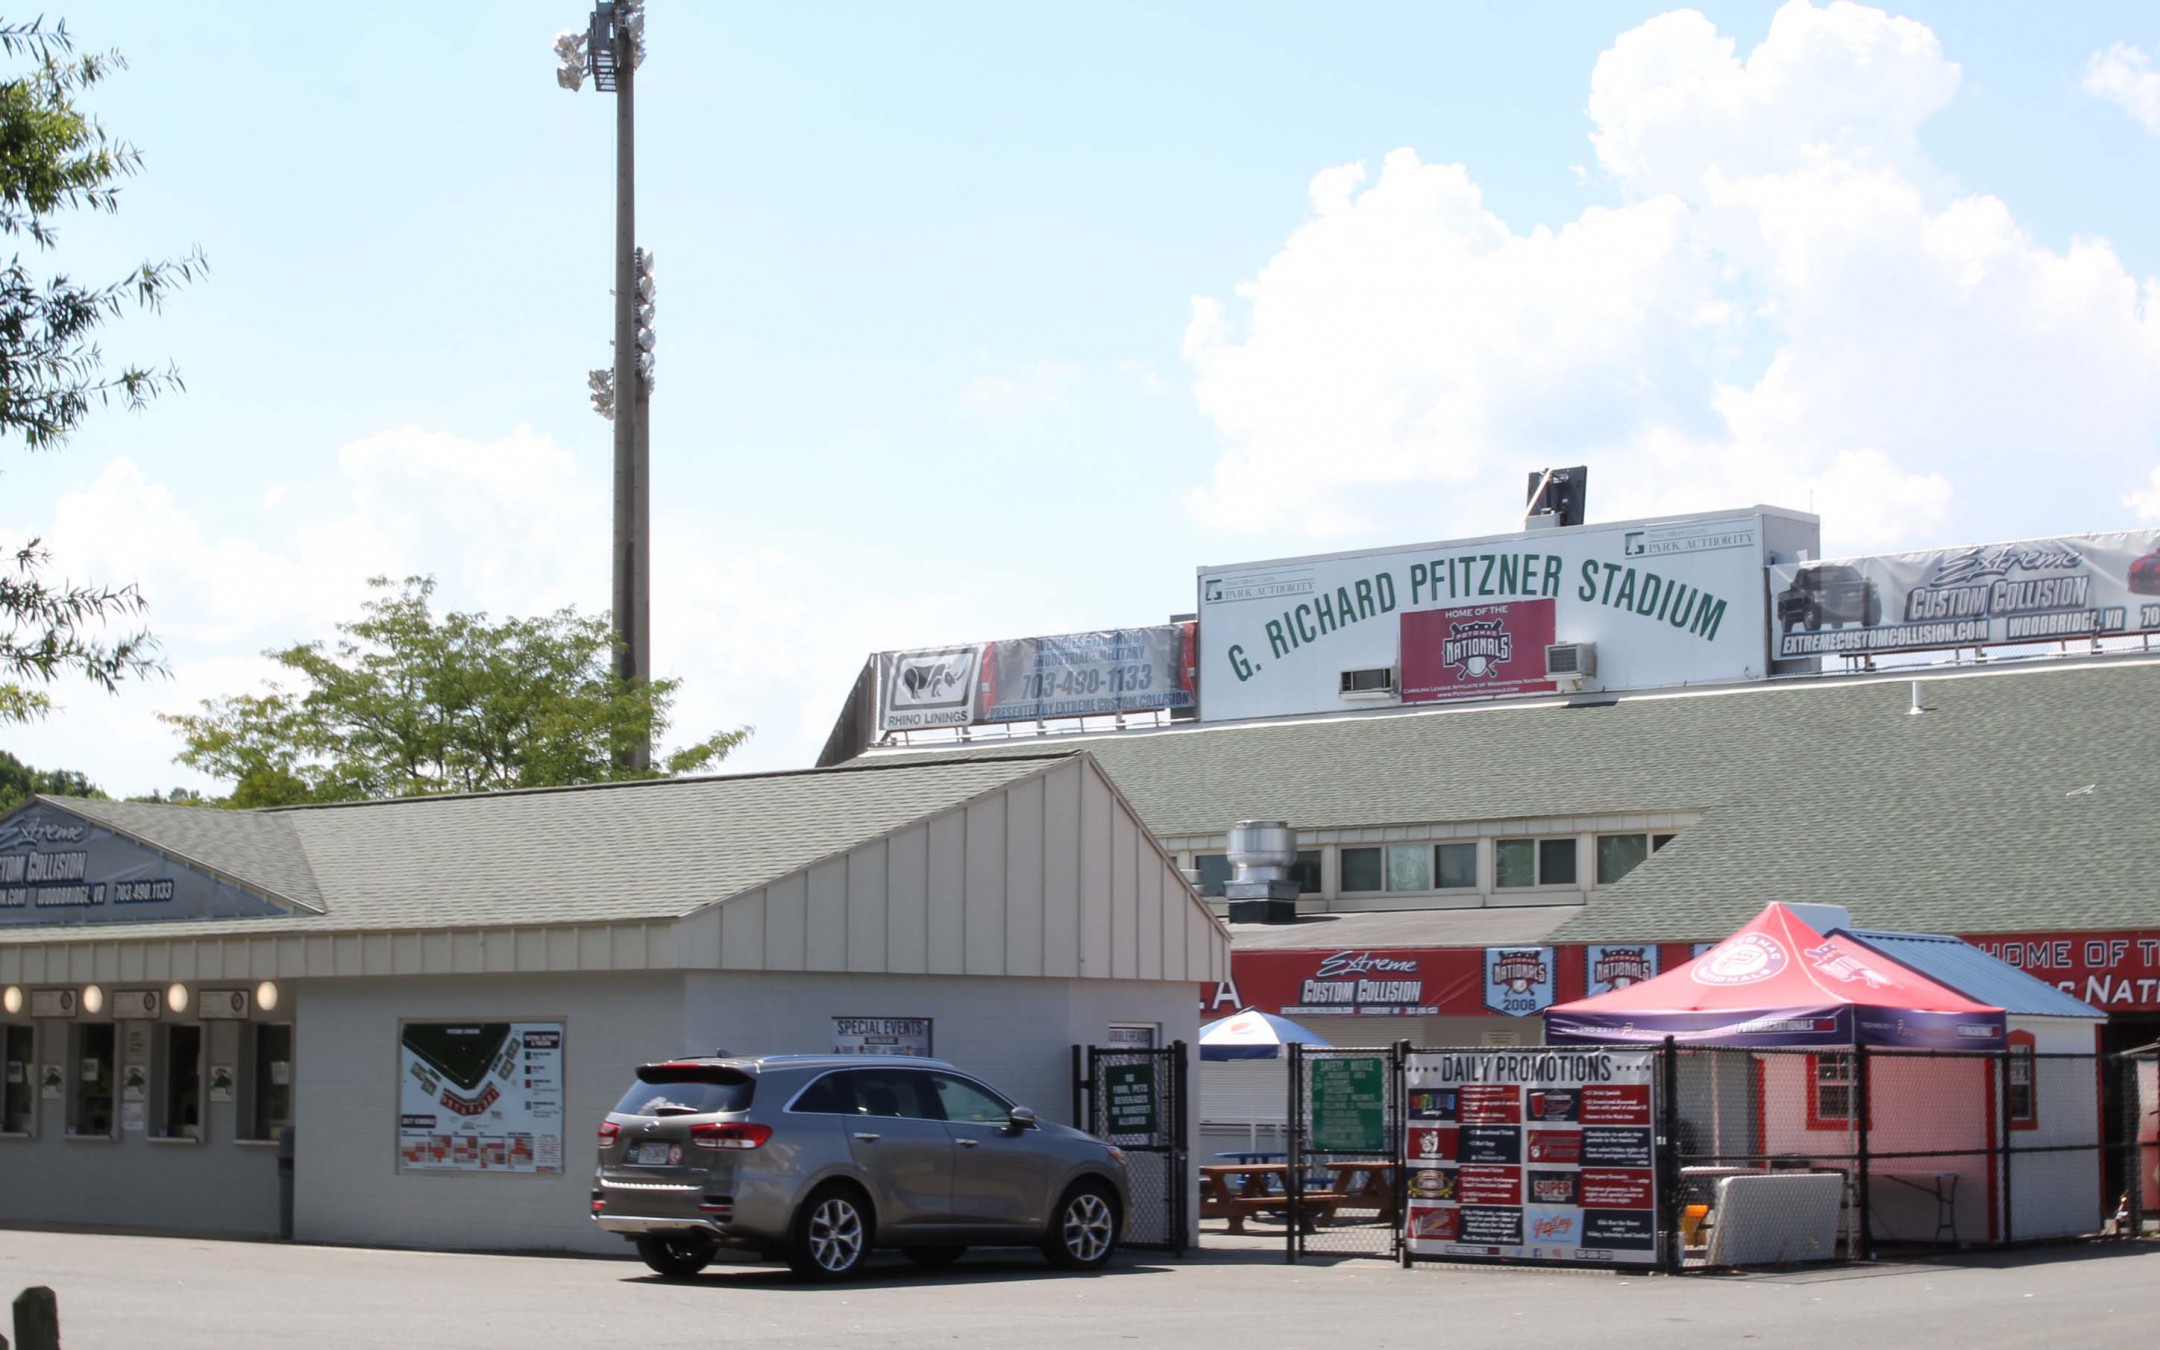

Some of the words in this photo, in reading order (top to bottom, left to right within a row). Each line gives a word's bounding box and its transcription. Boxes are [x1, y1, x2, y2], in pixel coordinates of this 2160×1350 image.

[1648, 541, 1680, 553] PARK
[1685, 533, 1754, 549] AUTHORITY
[1930, 545, 2082, 587] Extreme
[1225, 590, 1252, 599] PARK
[1257, 582, 1314, 596] AUTHORITY
[1908, 587, 1988, 620] CUSTOM
[1989, 576, 2089, 614] COLLISION
[1228, 644, 1261, 682] G.
[1265, 572, 1396, 659] RICHARD
[1410, 554, 1562, 605] PFITZNER
[1578, 559, 1727, 641] STADIUM
[1445, 609, 1473, 618] HOME
[1475, 607, 1488, 616] OF
[1489, 605, 1508, 614] THE
[1456, 630, 1498, 640] POTOMAC
[1783, 620, 1988, 654] EXTREMECUSTOMCOLLISION.COM
[1099, 646, 1145, 662] MILITARY
[1445, 637, 1509, 663] NATIONALS
[1022, 664, 1152, 700] 703-490-1133
[1055, 699, 1096, 715] EXTREME
[1138, 692, 1189, 708] COLLISION
[889, 714, 921, 727] RHINO
[924, 711, 968, 725] LININGS
[1315, 950, 1418, 977] Extreme
[1978, 941, 2072, 969] HOME
[2085, 939, 2129, 968] OF
[1494, 963, 1546, 983] NATIONALS
[1596, 960, 1651, 982] NATIONALS
[1302, 979, 1354, 1003] CUSTOM
[1355, 979, 1422, 1003] COLLISION
[1503, 998, 1536, 1011] 2008
[838, 1020, 881, 1035] SPECIAL
[884, 1020, 923, 1035] EVENTS
[1442, 1056, 1491, 1082] DAILY
[1496, 1055, 1612, 1082] PROMOTIONS
[1536, 1182, 1570, 1195] SUPER
